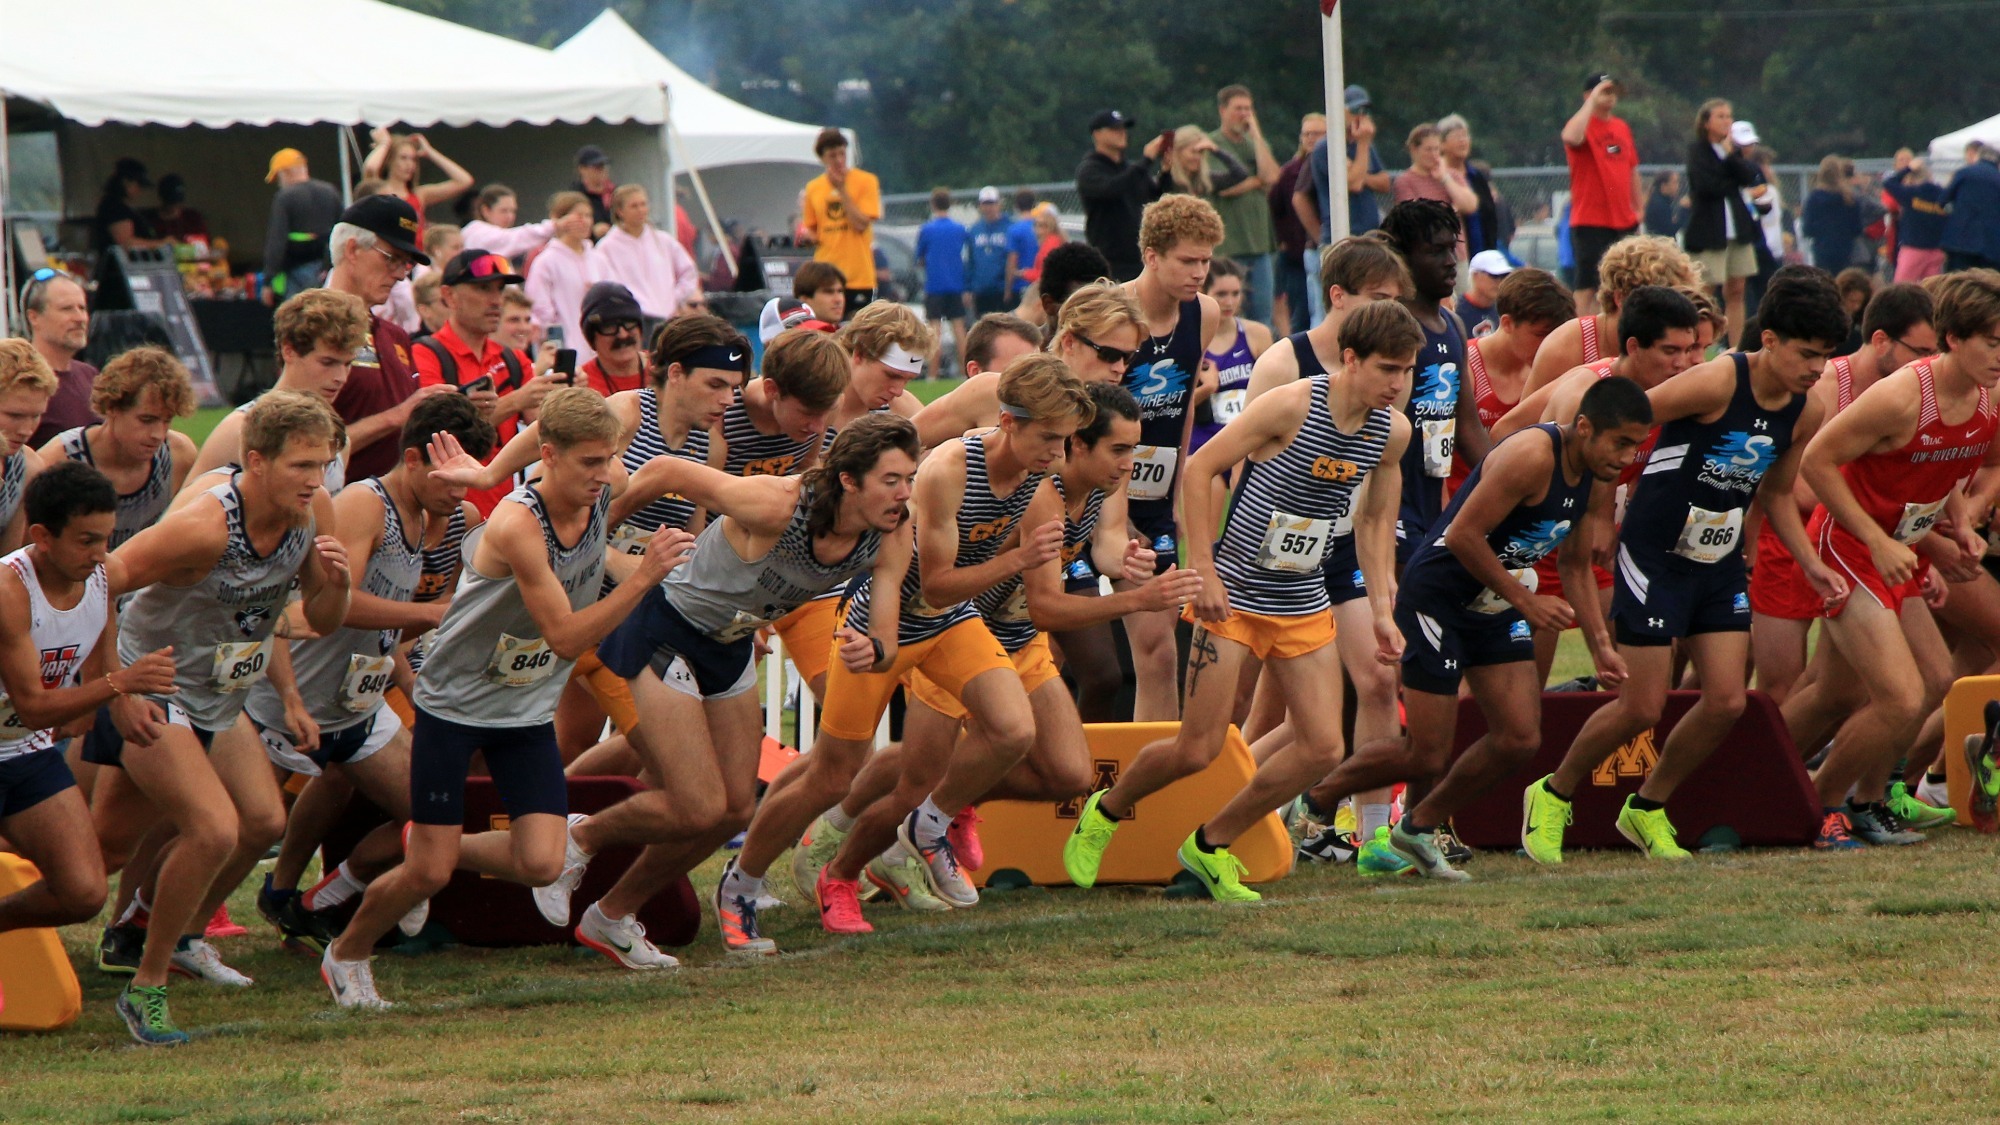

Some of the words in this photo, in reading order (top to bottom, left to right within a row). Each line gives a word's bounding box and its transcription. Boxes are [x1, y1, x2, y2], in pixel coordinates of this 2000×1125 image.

[1218, 362, 1253, 385] HOMAS
[1134, 389, 1187, 409] UTHEAST
[1311, 456, 1358, 483] CSP
[1702, 459, 1764, 484] SOUTHEAS
[1280, 532, 1319, 556] 557
[1699, 527, 1735, 546] 866
[230, 653, 264, 679] 850
[510, 649, 552, 671] 846
[357, 673, 387, 694] 849
